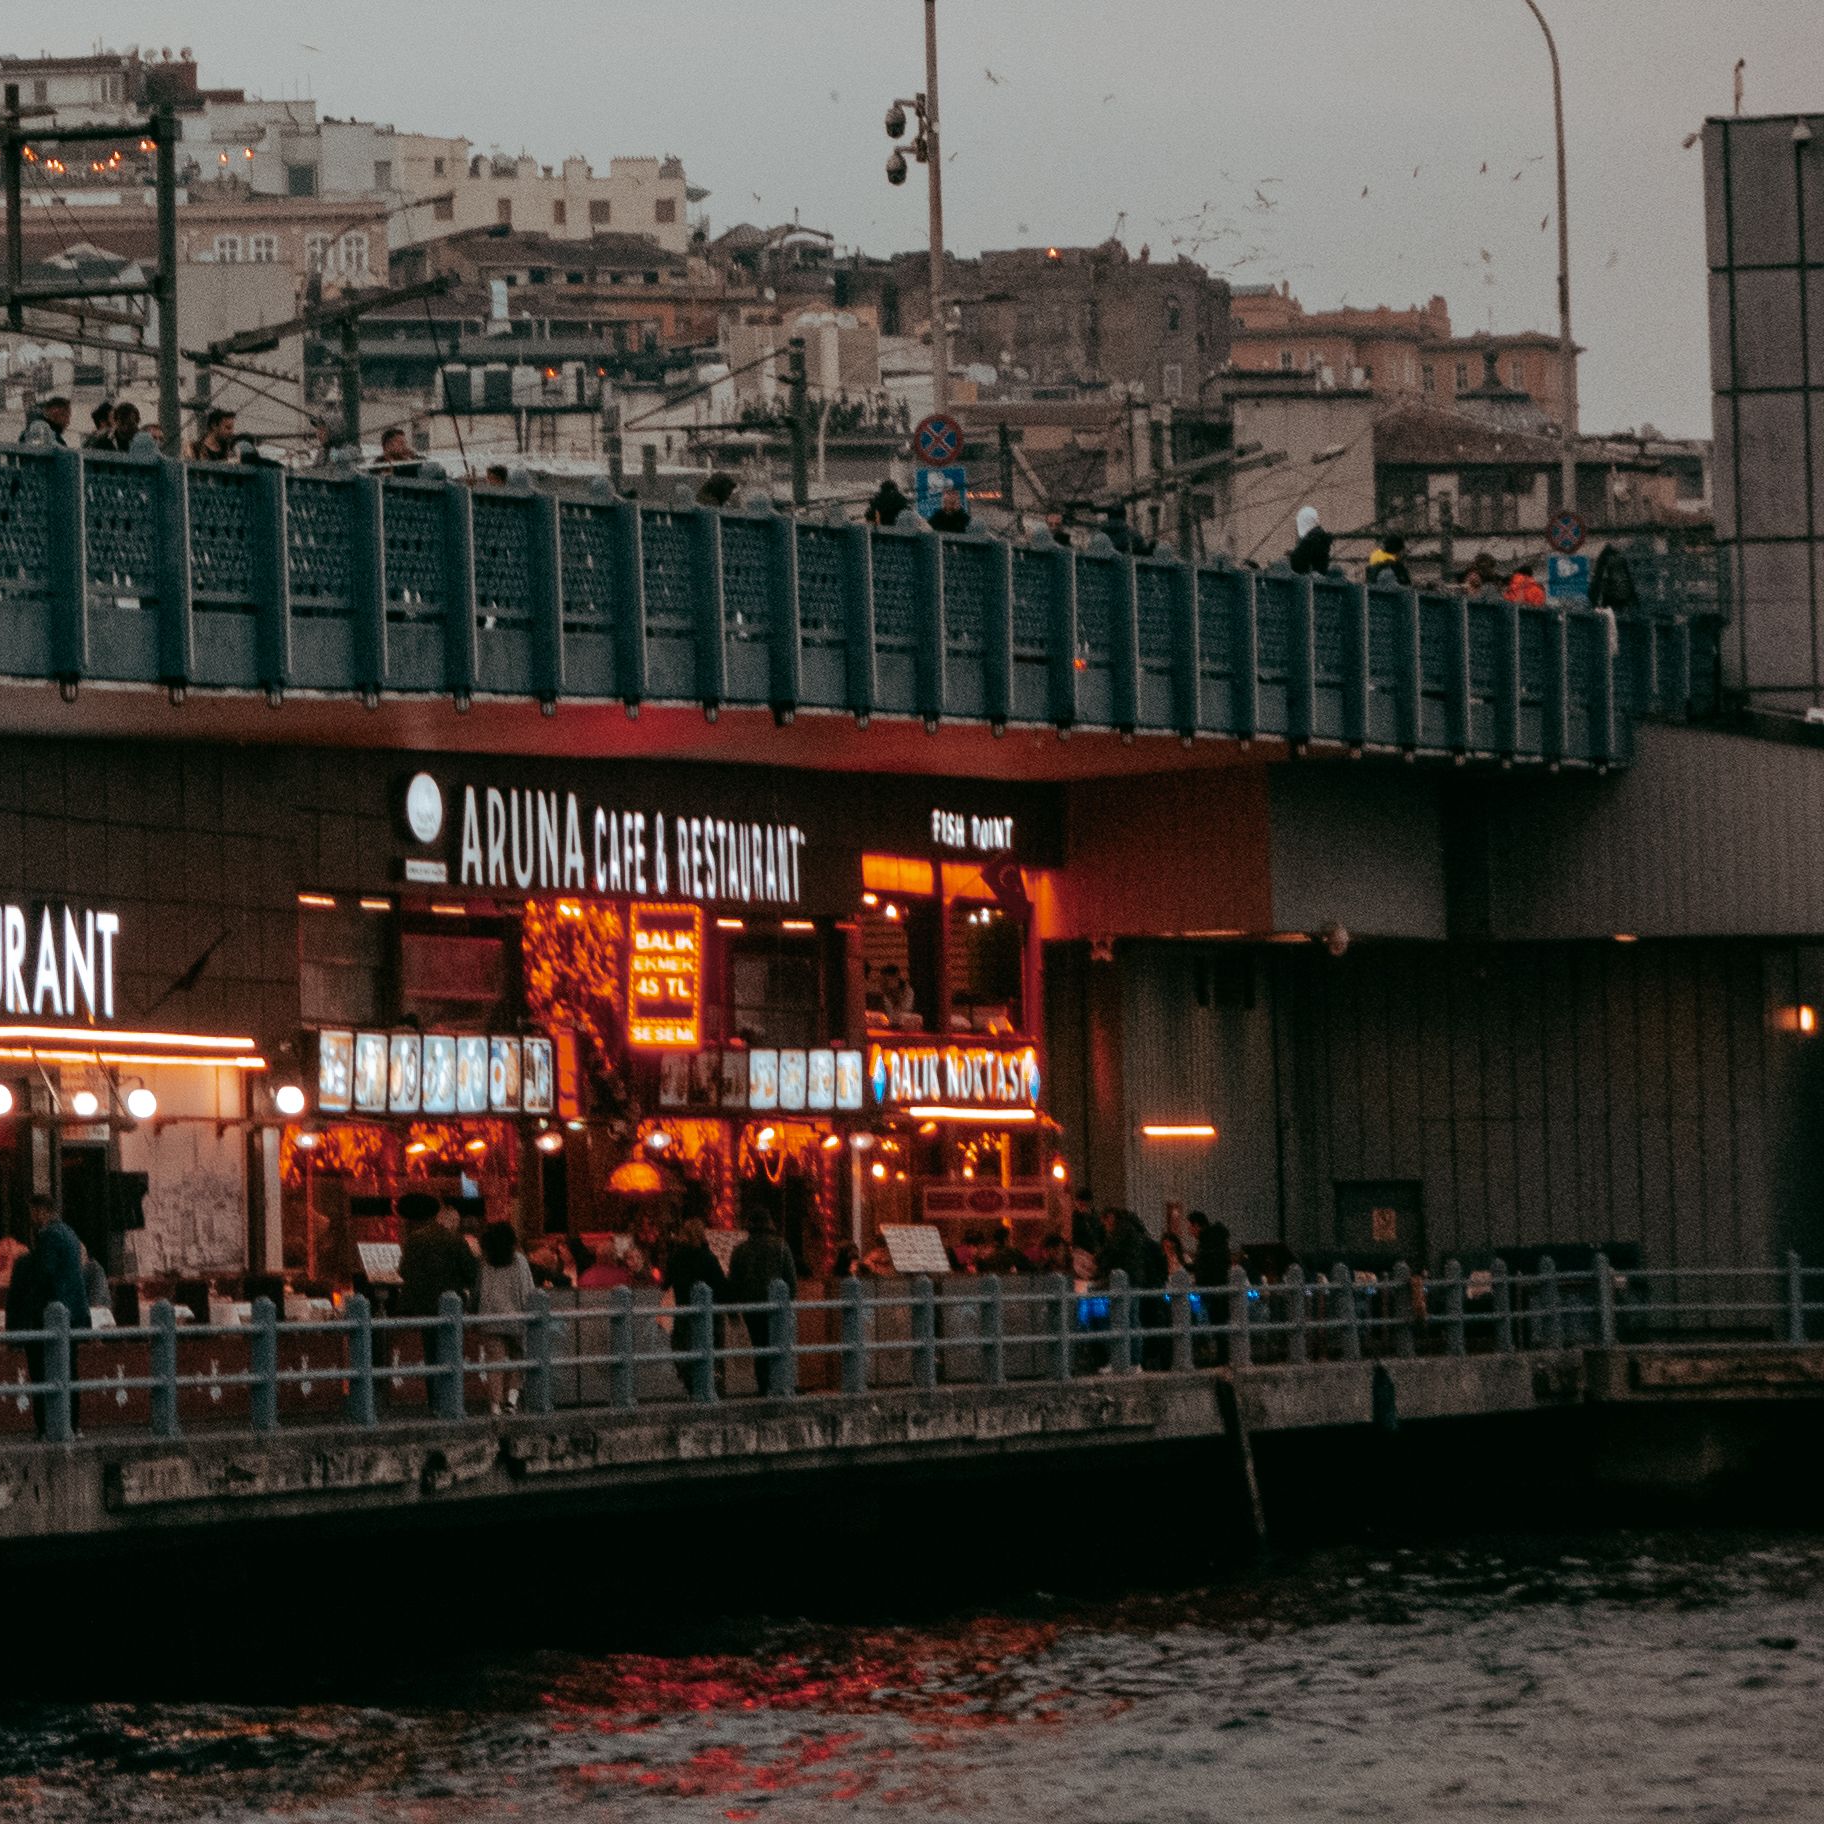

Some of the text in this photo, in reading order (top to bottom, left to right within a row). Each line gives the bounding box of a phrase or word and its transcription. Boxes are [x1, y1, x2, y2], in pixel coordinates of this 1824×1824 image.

[460, 784, 802, 904] ARUNA CAFE & RESTAURANT
[932, 808, 1014, 851] FISH POINT
[635, 930, 694, 950] BALIK
[633, 955, 694, 972] EKMEK
[636, 976, 692, 997] 45 TL
[890, 1050, 1028, 1102] BALIK NOKTASI
